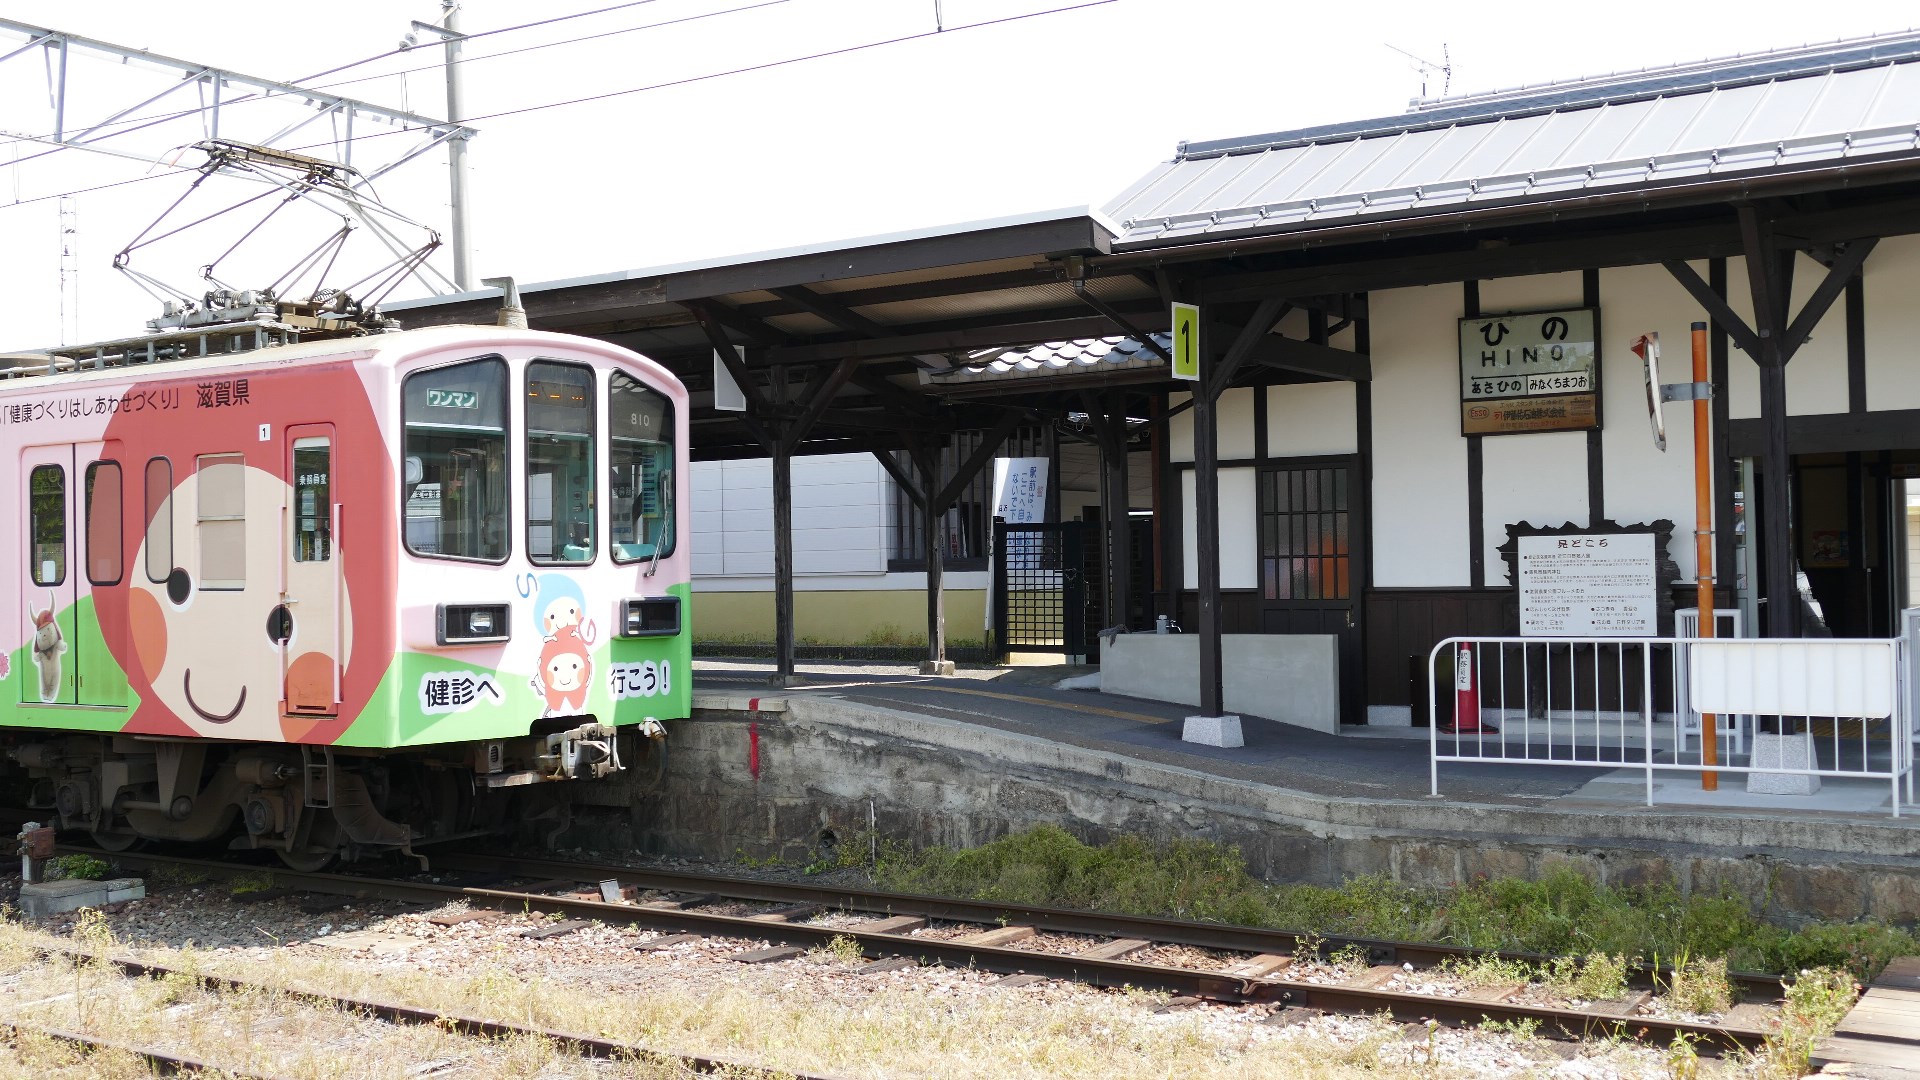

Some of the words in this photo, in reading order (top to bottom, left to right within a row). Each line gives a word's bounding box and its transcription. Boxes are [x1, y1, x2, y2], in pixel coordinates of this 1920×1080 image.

[1480, 316, 1569, 347] ひの
[1181, 319, 1190, 364] 1
[1481, 345, 1564, 368] HINO
[1471, 380, 1522, 395] あさひの
[1529, 375, 1588, 390] みなくちまつお
[196, 378, 250, 409] 滋賀県
[429, 389, 475, 407] ワンマン
[630, 412, 650, 427] 810
[1470, 409, 1488, 418] ESSO
[262, 427, 267, 439] 1
[1557, 538, 1608, 549] 見どころ
[424, 677, 500, 709] 健診へ
